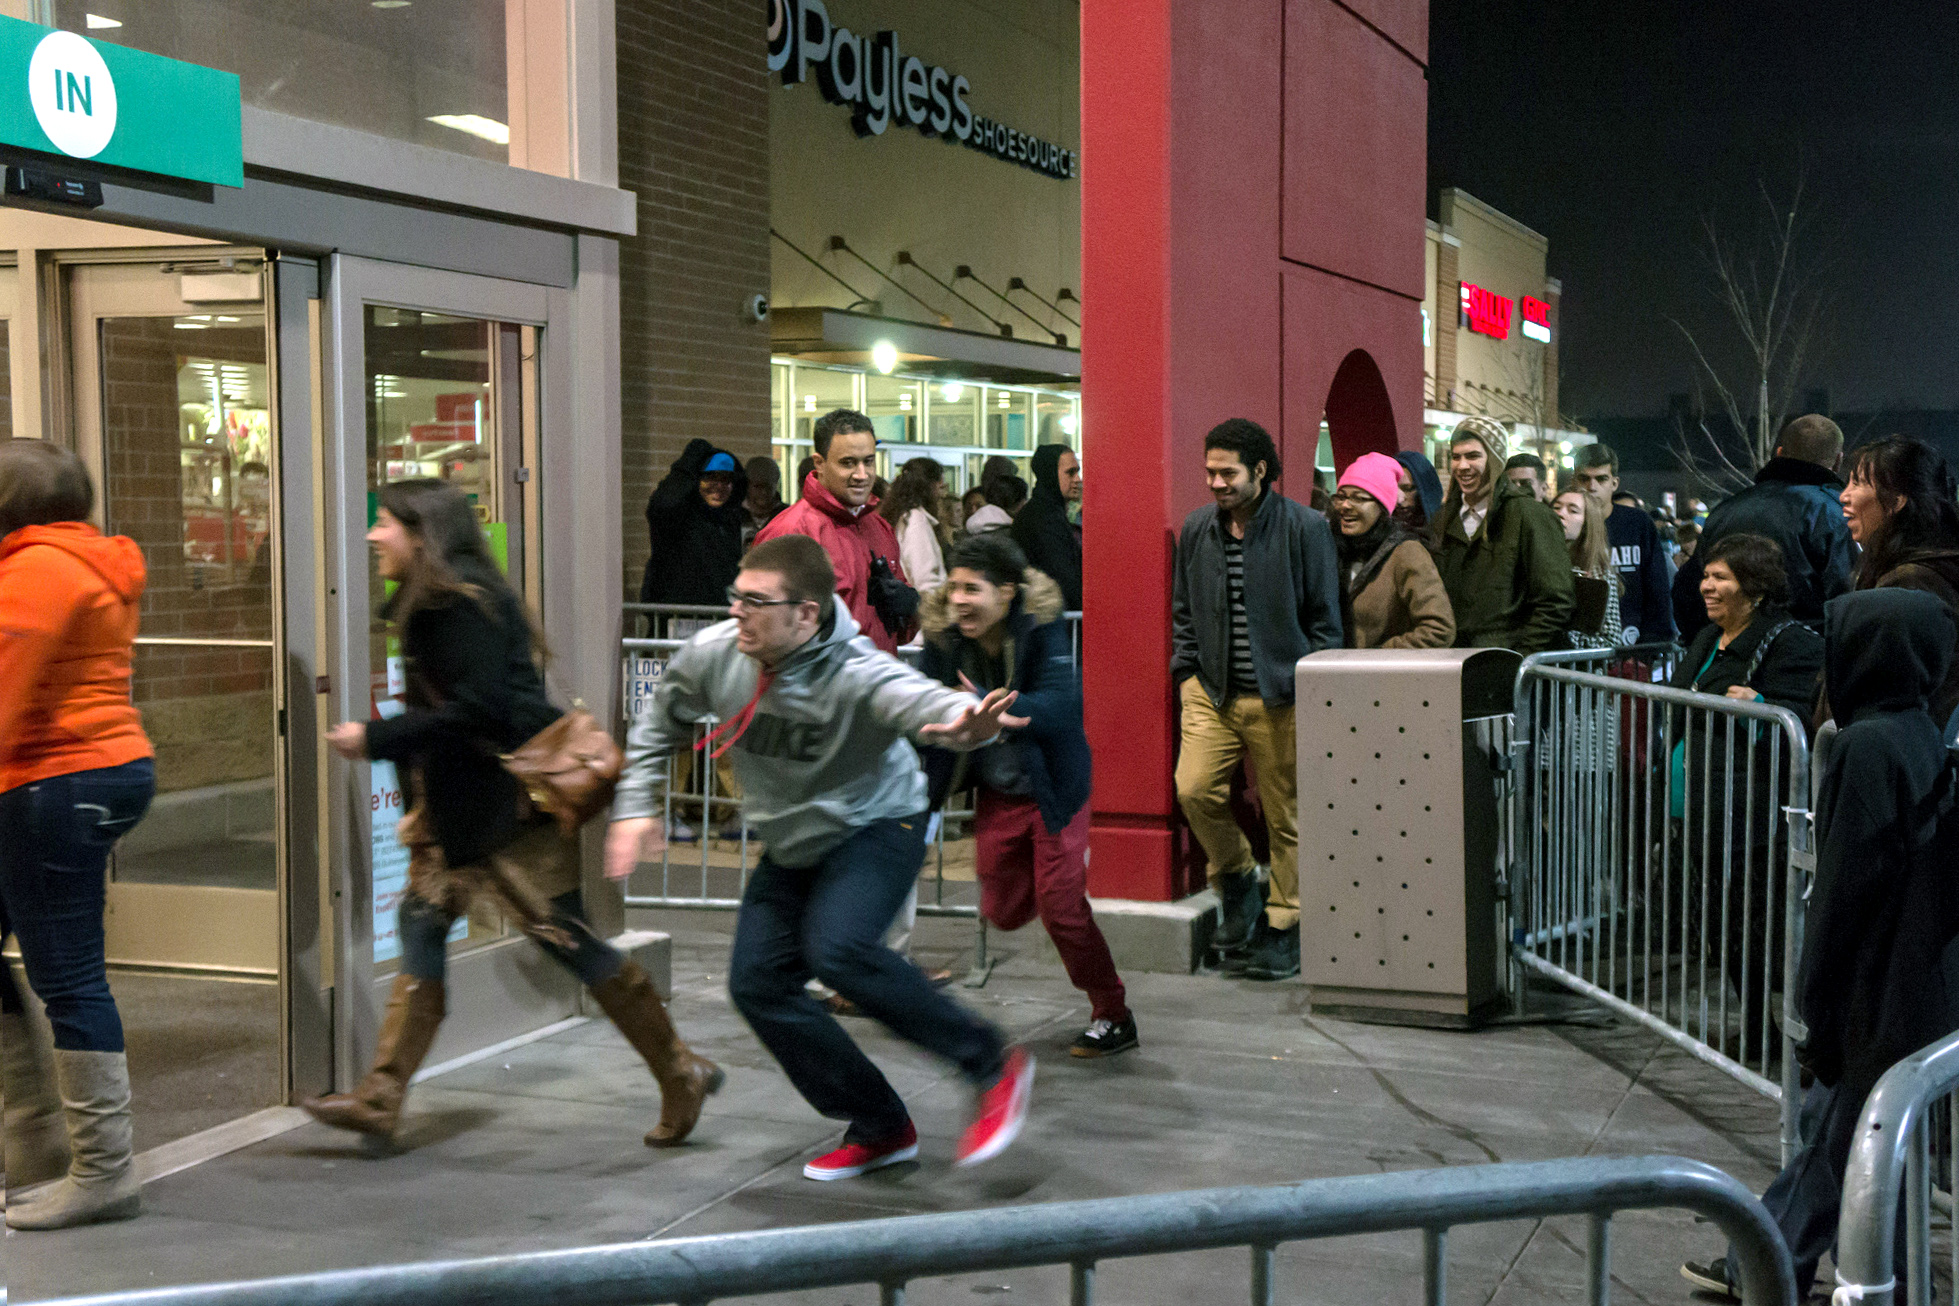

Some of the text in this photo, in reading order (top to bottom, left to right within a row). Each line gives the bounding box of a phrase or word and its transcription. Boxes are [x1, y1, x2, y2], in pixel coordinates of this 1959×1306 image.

[54, 68, 93, 117] IN
[798, 0, 1076, 178] Payless SHOESOURCE
[1610, 545, 1641, 566] AHO
[371, 787, 400, 811] e're
